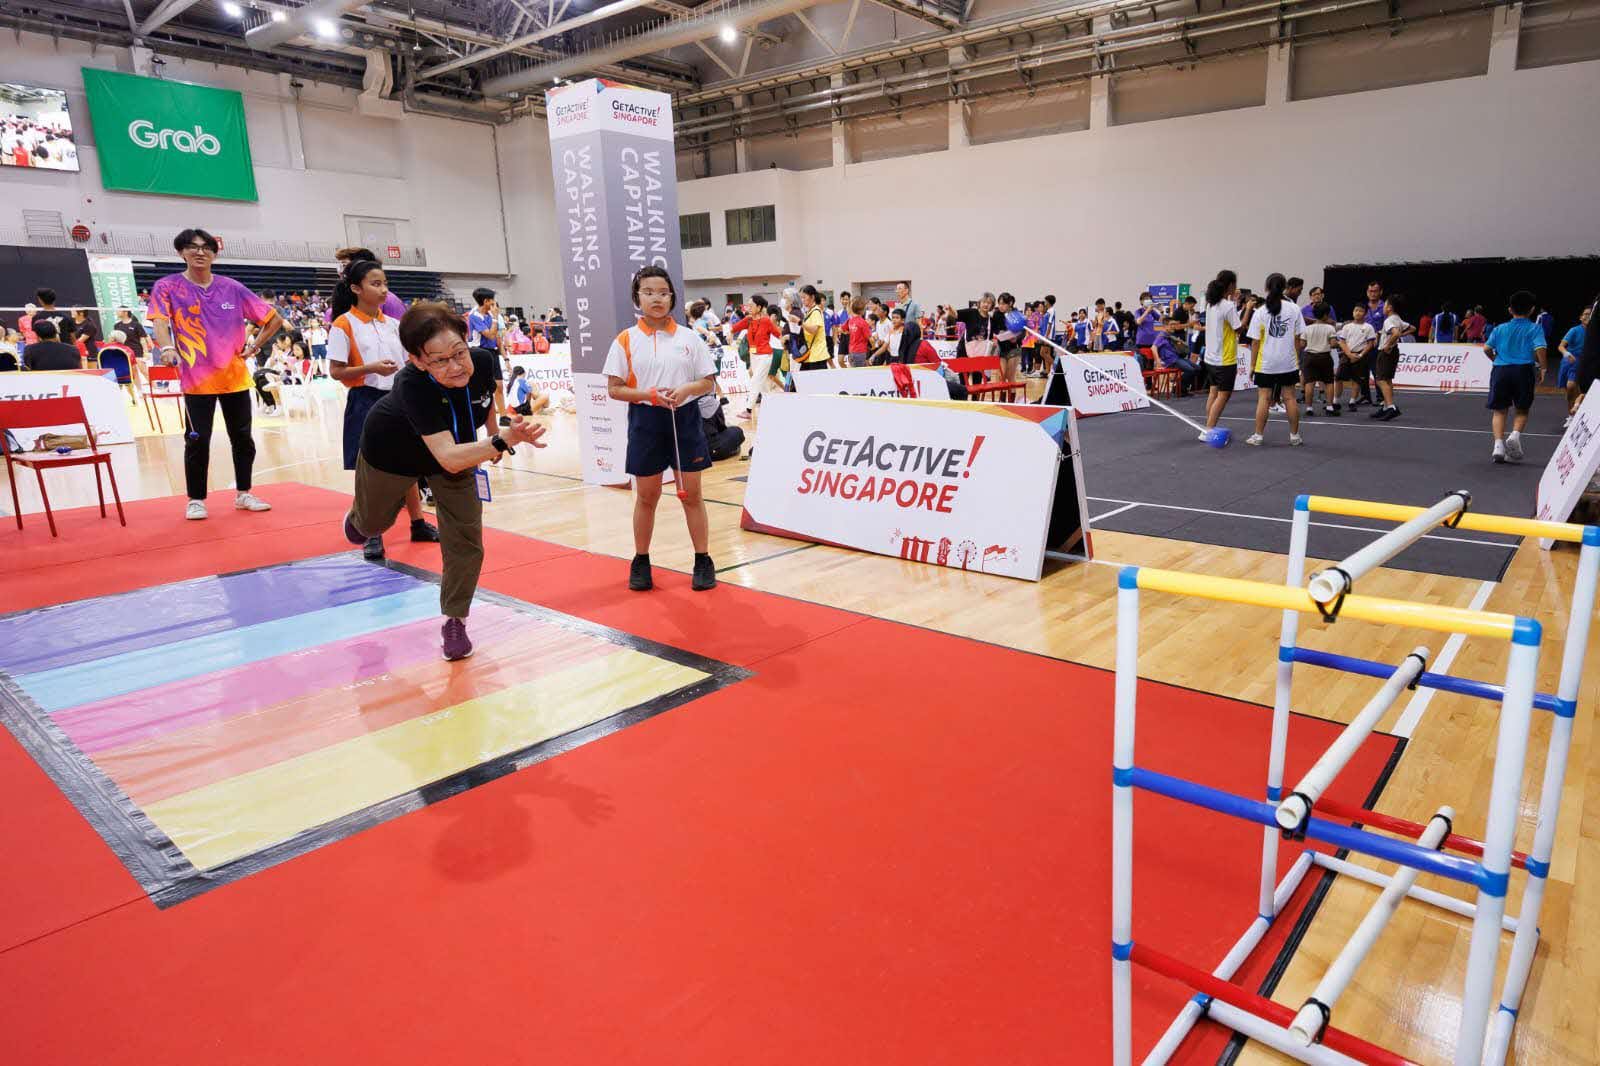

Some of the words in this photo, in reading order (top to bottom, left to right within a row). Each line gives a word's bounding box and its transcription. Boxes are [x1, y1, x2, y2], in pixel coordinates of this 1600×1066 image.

[128, 120, 221, 155] Grab
[613, 111, 657, 126] SINGAPORE
[579, 145, 601, 271] WALKING
[563, 150, 587, 288] CAPTAIN'S
[576, 297, 593, 357] BALL
[1396, 364, 1461, 374] SINGAPORE
[803, 430, 986, 479] GETACTIVE!
[797, 468, 959, 513] SINGAPORE
